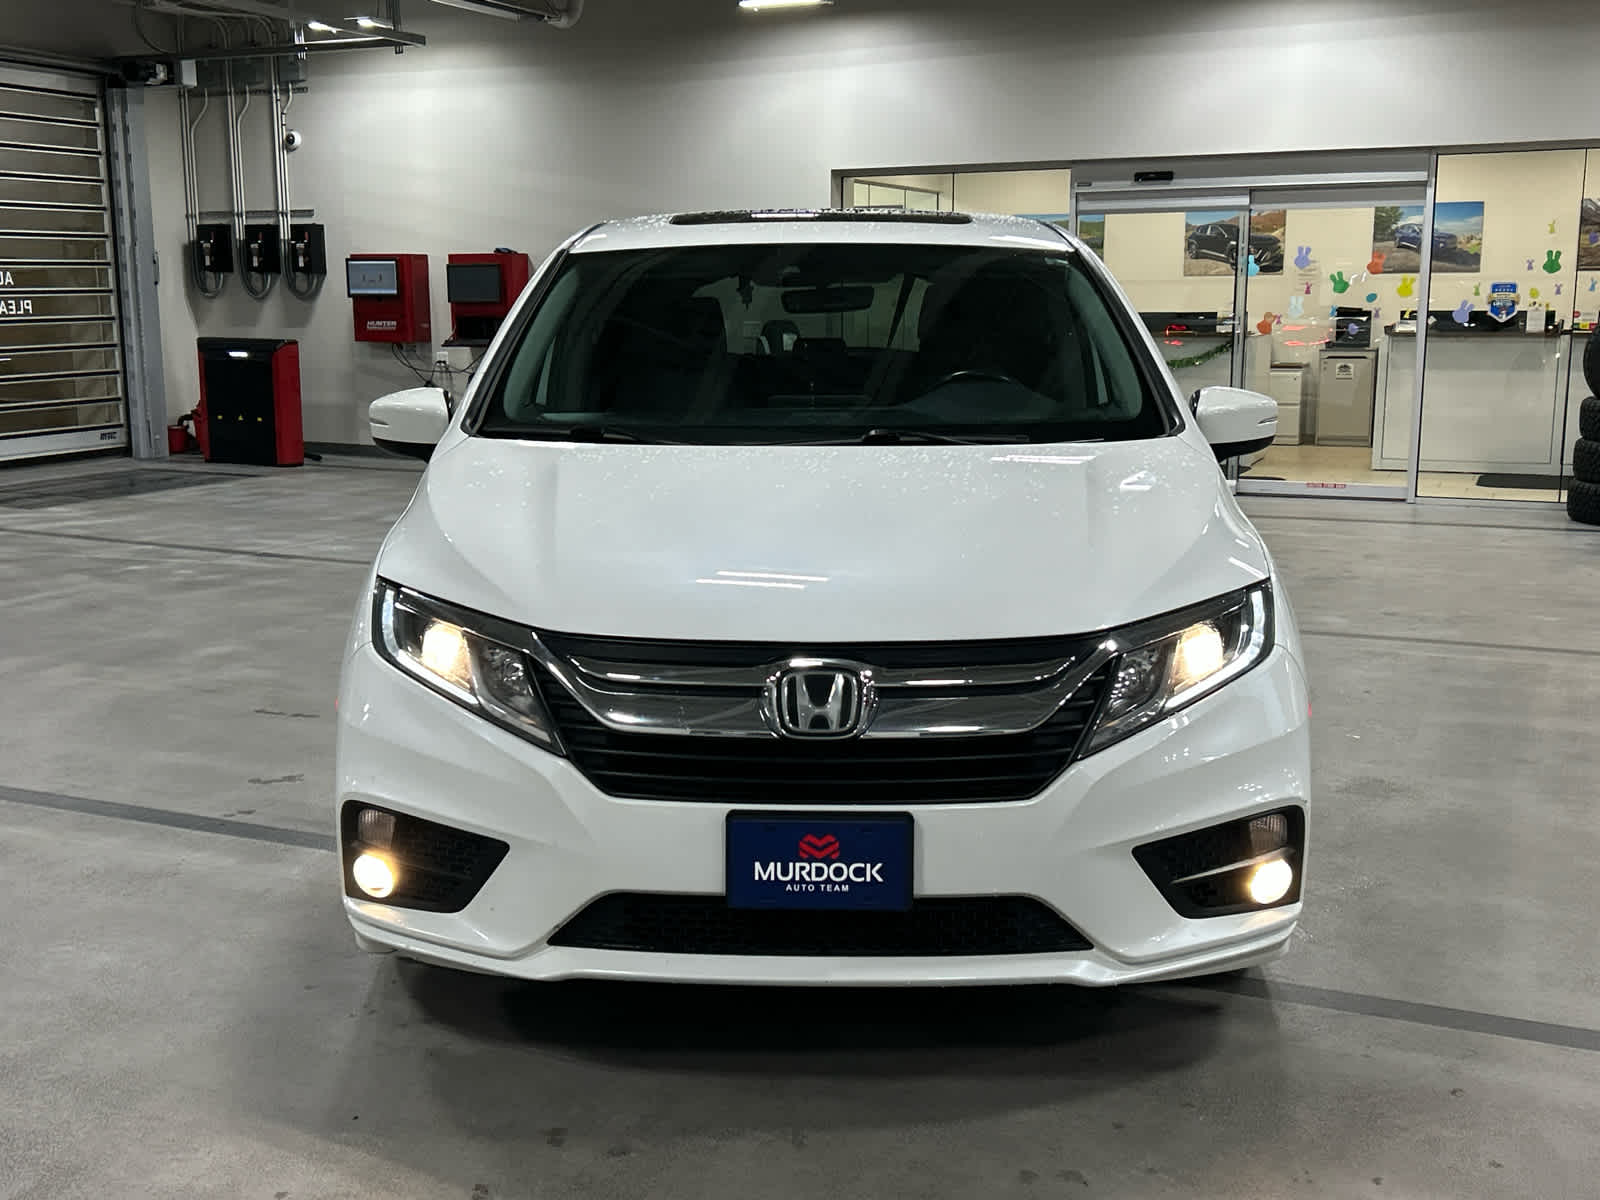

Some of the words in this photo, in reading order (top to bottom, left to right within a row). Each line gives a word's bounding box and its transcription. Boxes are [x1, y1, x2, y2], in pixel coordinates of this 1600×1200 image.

[366, 320, 398, 328] HUNTER
[754, 861, 884, 882] MURDOCK
[785, 883, 815, 892] AUTO
[819, 883, 849, 892] TEAM
